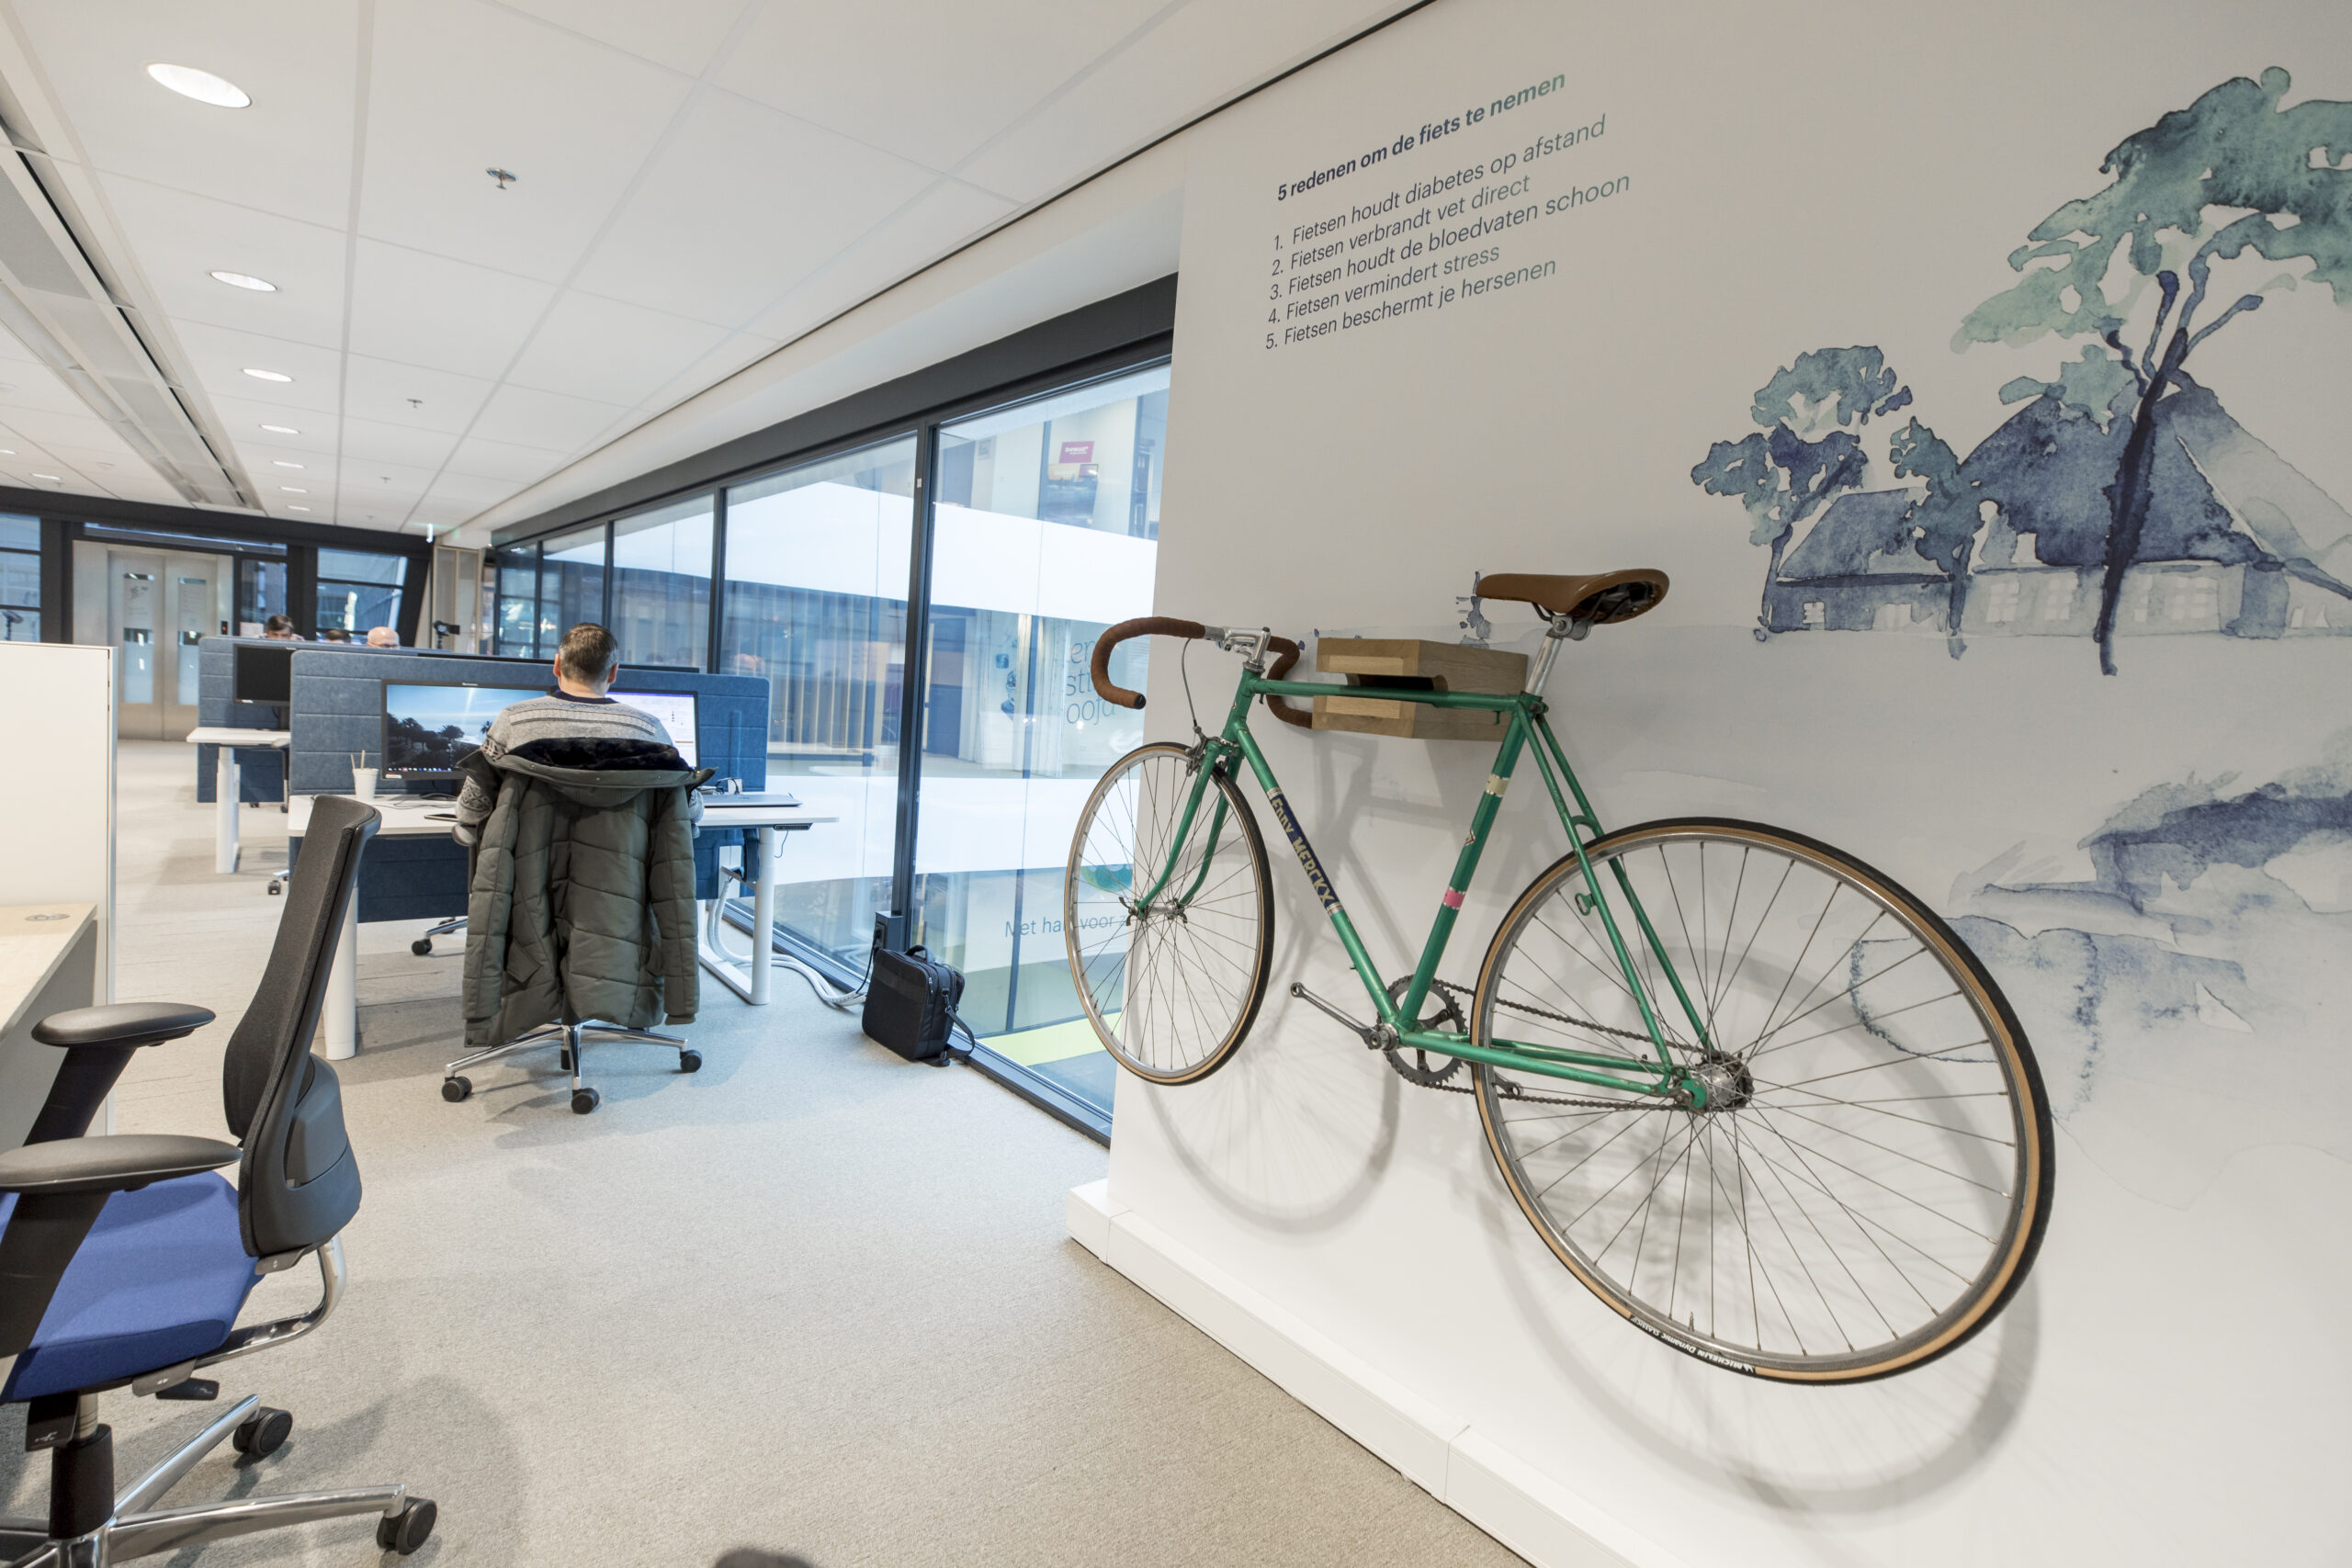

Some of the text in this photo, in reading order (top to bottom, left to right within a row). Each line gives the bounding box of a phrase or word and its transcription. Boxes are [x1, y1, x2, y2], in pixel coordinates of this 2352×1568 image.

[1274, 113, 1606, 251] 1. Fietsen houdt diabetes op afstand
[1277, 73, 1566, 202] 5 redenen om de fiets te nemen
[1270, 175, 1630, 300] 3. Fietsen houdt de bloedvaten schoon
[1271, 175, 1531, 276] 2. Fietsen verbrandt vet direct
[1265, 260, 1556, 350] 5. Fietsen beschermt je hersenen
[1267, 246, 1499, 324] 4. Fietsen vermindert stress
[1080, 915, 1115, 930] voor
[1697, 1348, 1744, 1371] MICHELIN
